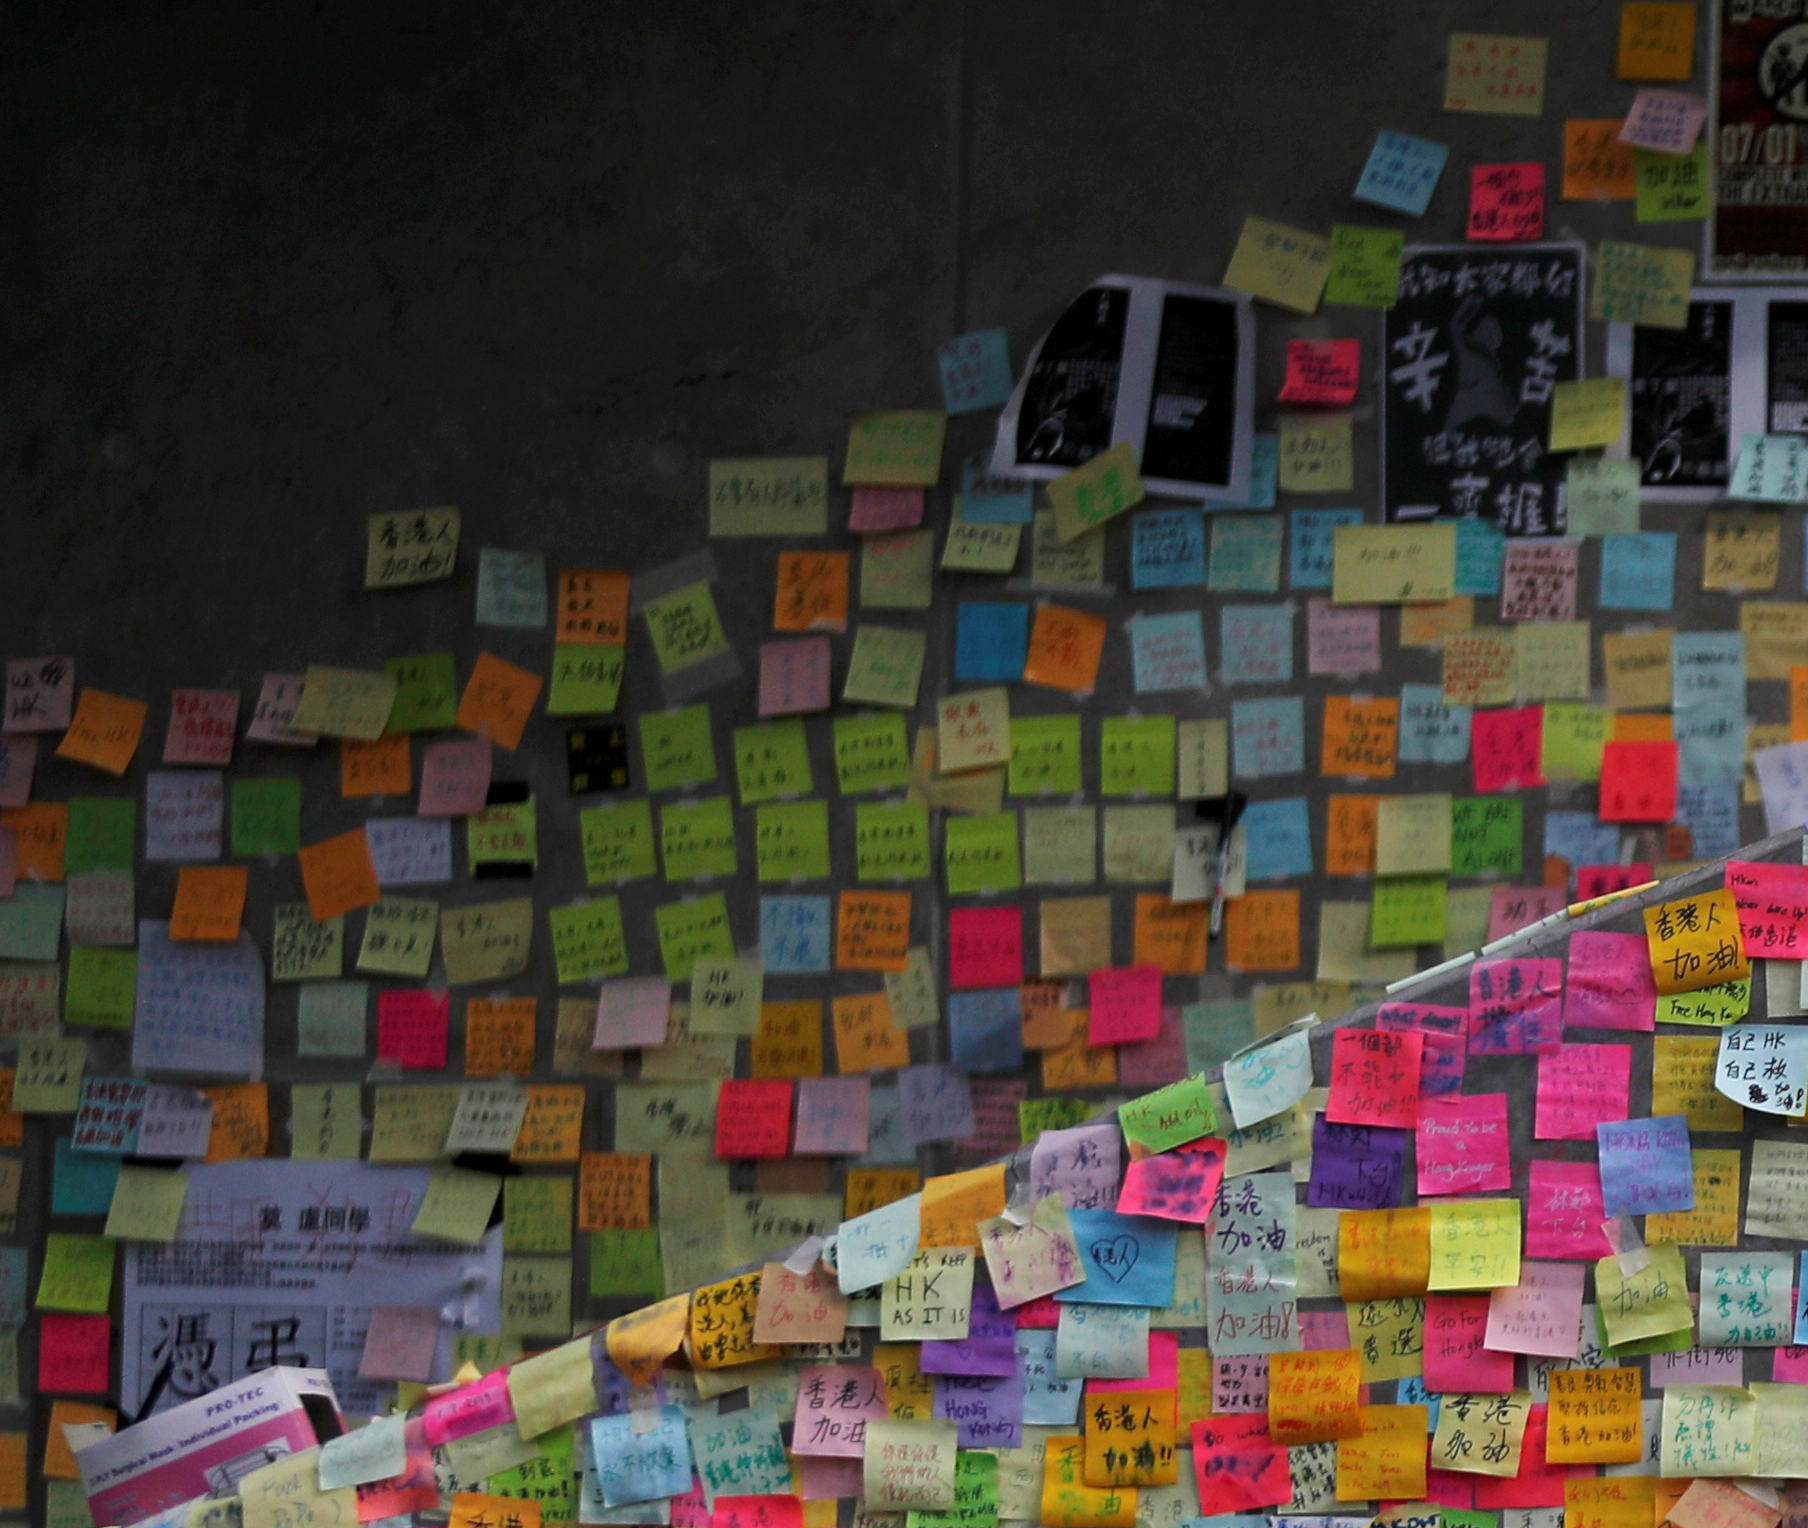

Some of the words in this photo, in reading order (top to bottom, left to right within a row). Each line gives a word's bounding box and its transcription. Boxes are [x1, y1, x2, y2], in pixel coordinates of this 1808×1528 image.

[1654, 902, 1721, 937] 香港人
[894, 1271, 945, 1301] HK
